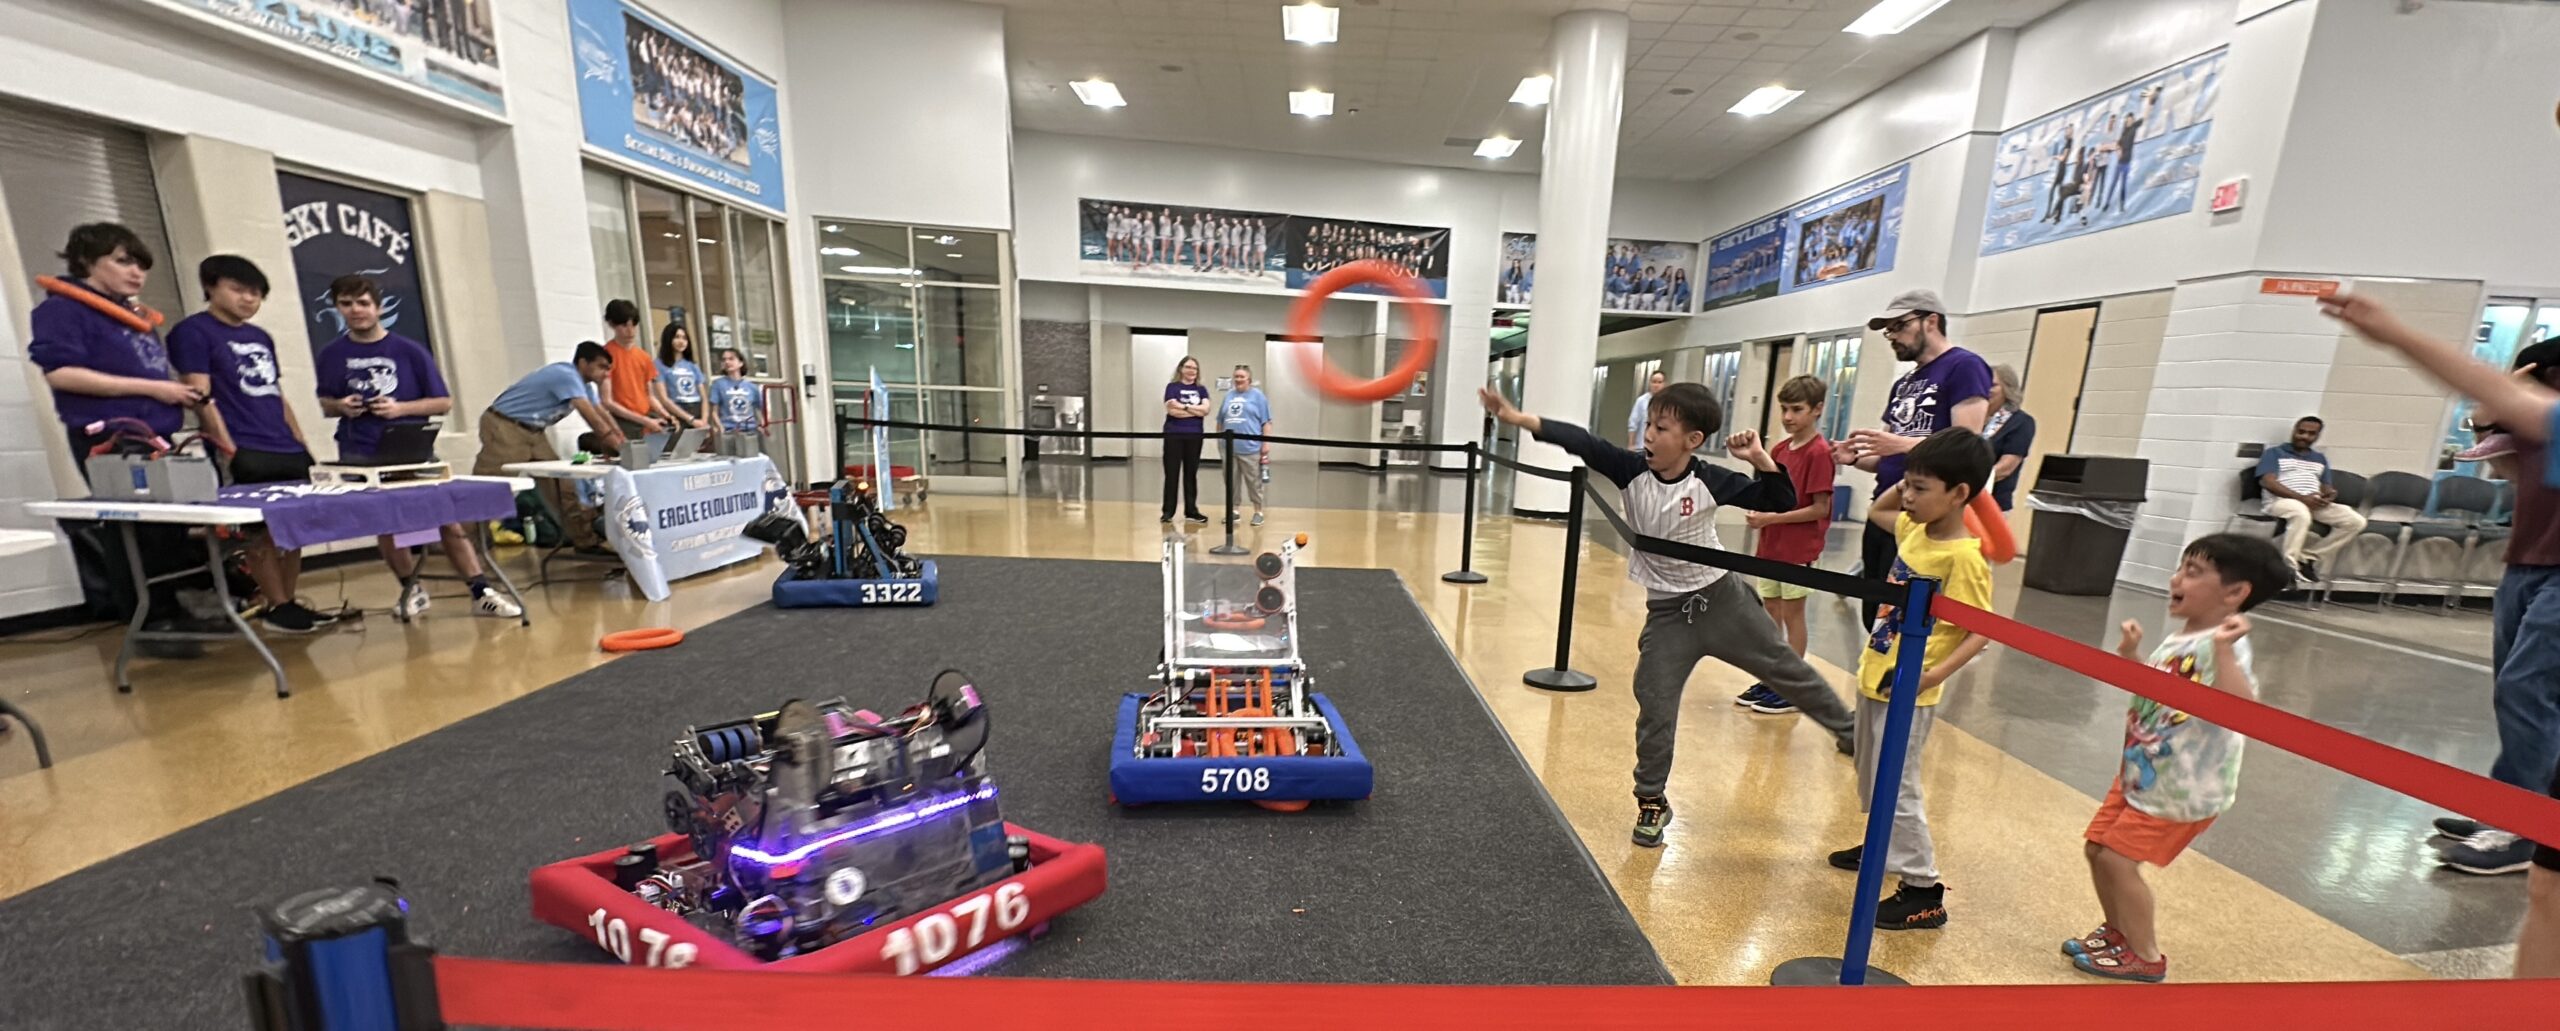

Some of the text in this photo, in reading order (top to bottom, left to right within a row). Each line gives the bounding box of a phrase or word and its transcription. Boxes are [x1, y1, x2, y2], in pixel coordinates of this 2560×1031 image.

[284, 201, 410, 264] SKY CAFÉ
[658, 502, 699, 529] EAGLE
[861, 583, 922, 603] 3322
[1201, 767, 1270, 793] 5708
[880, 882, 1030, 976] 1076
